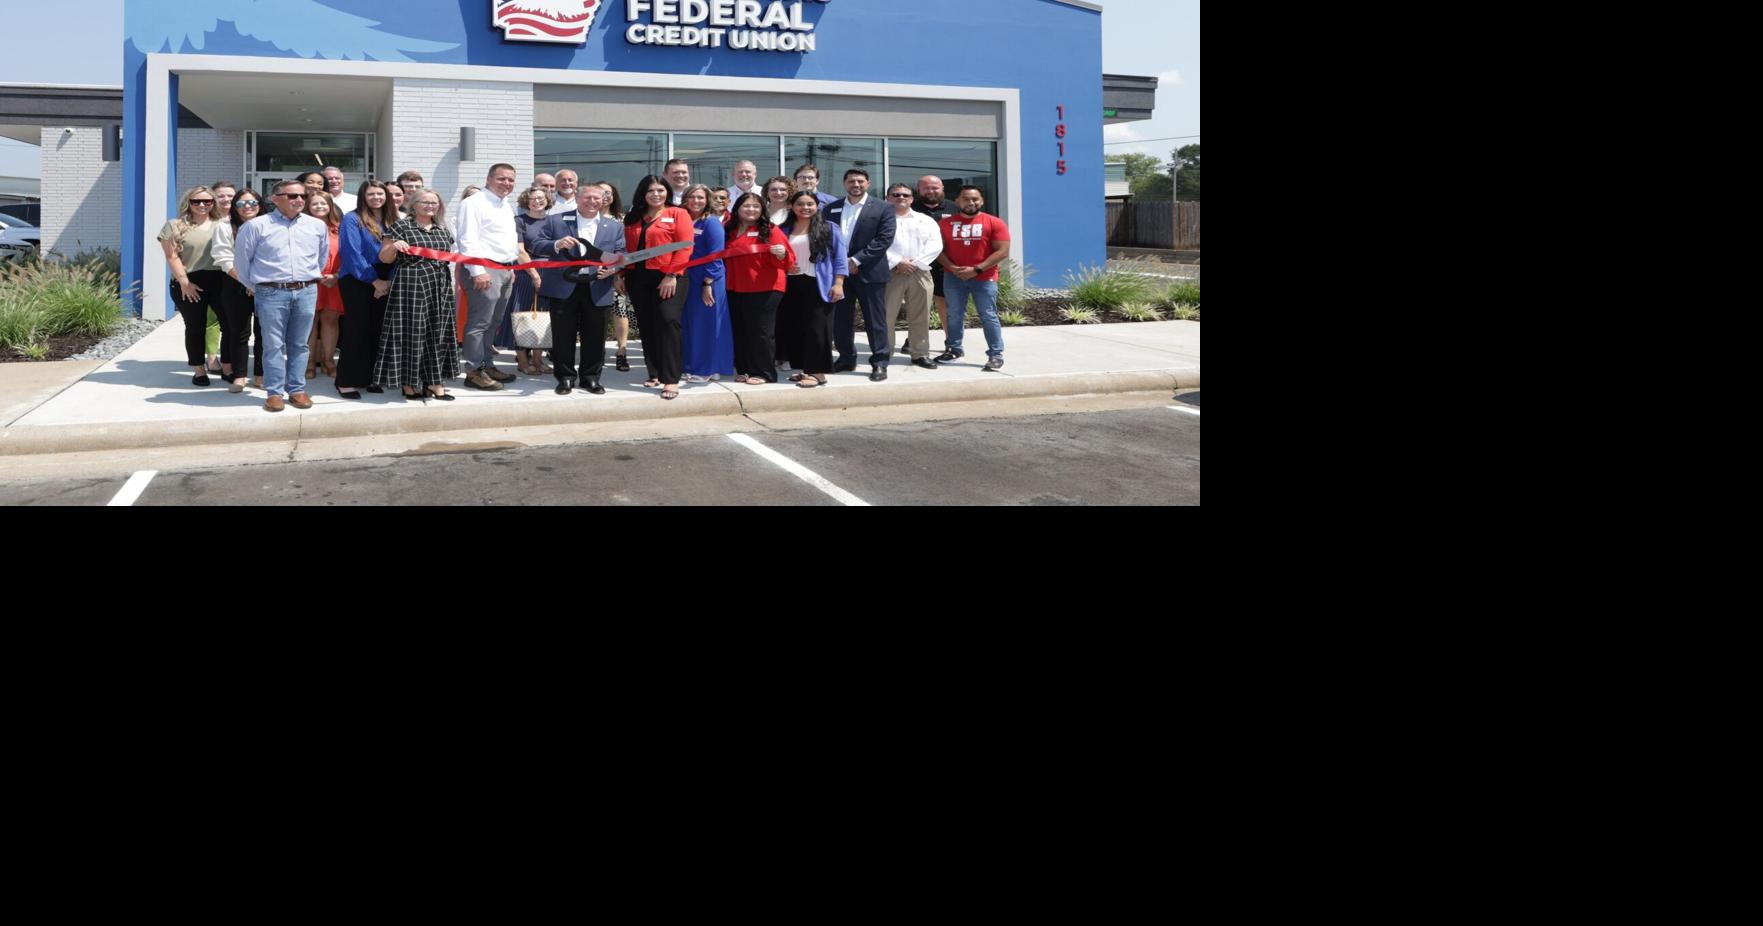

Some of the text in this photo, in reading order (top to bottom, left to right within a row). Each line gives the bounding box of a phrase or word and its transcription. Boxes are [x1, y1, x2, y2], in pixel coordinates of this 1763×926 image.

[627, 0, 814, 31] FEDERAL
[626, 23, 816, 51] CREDIT UNION
[1055, 104, 1067, 176] 1815
